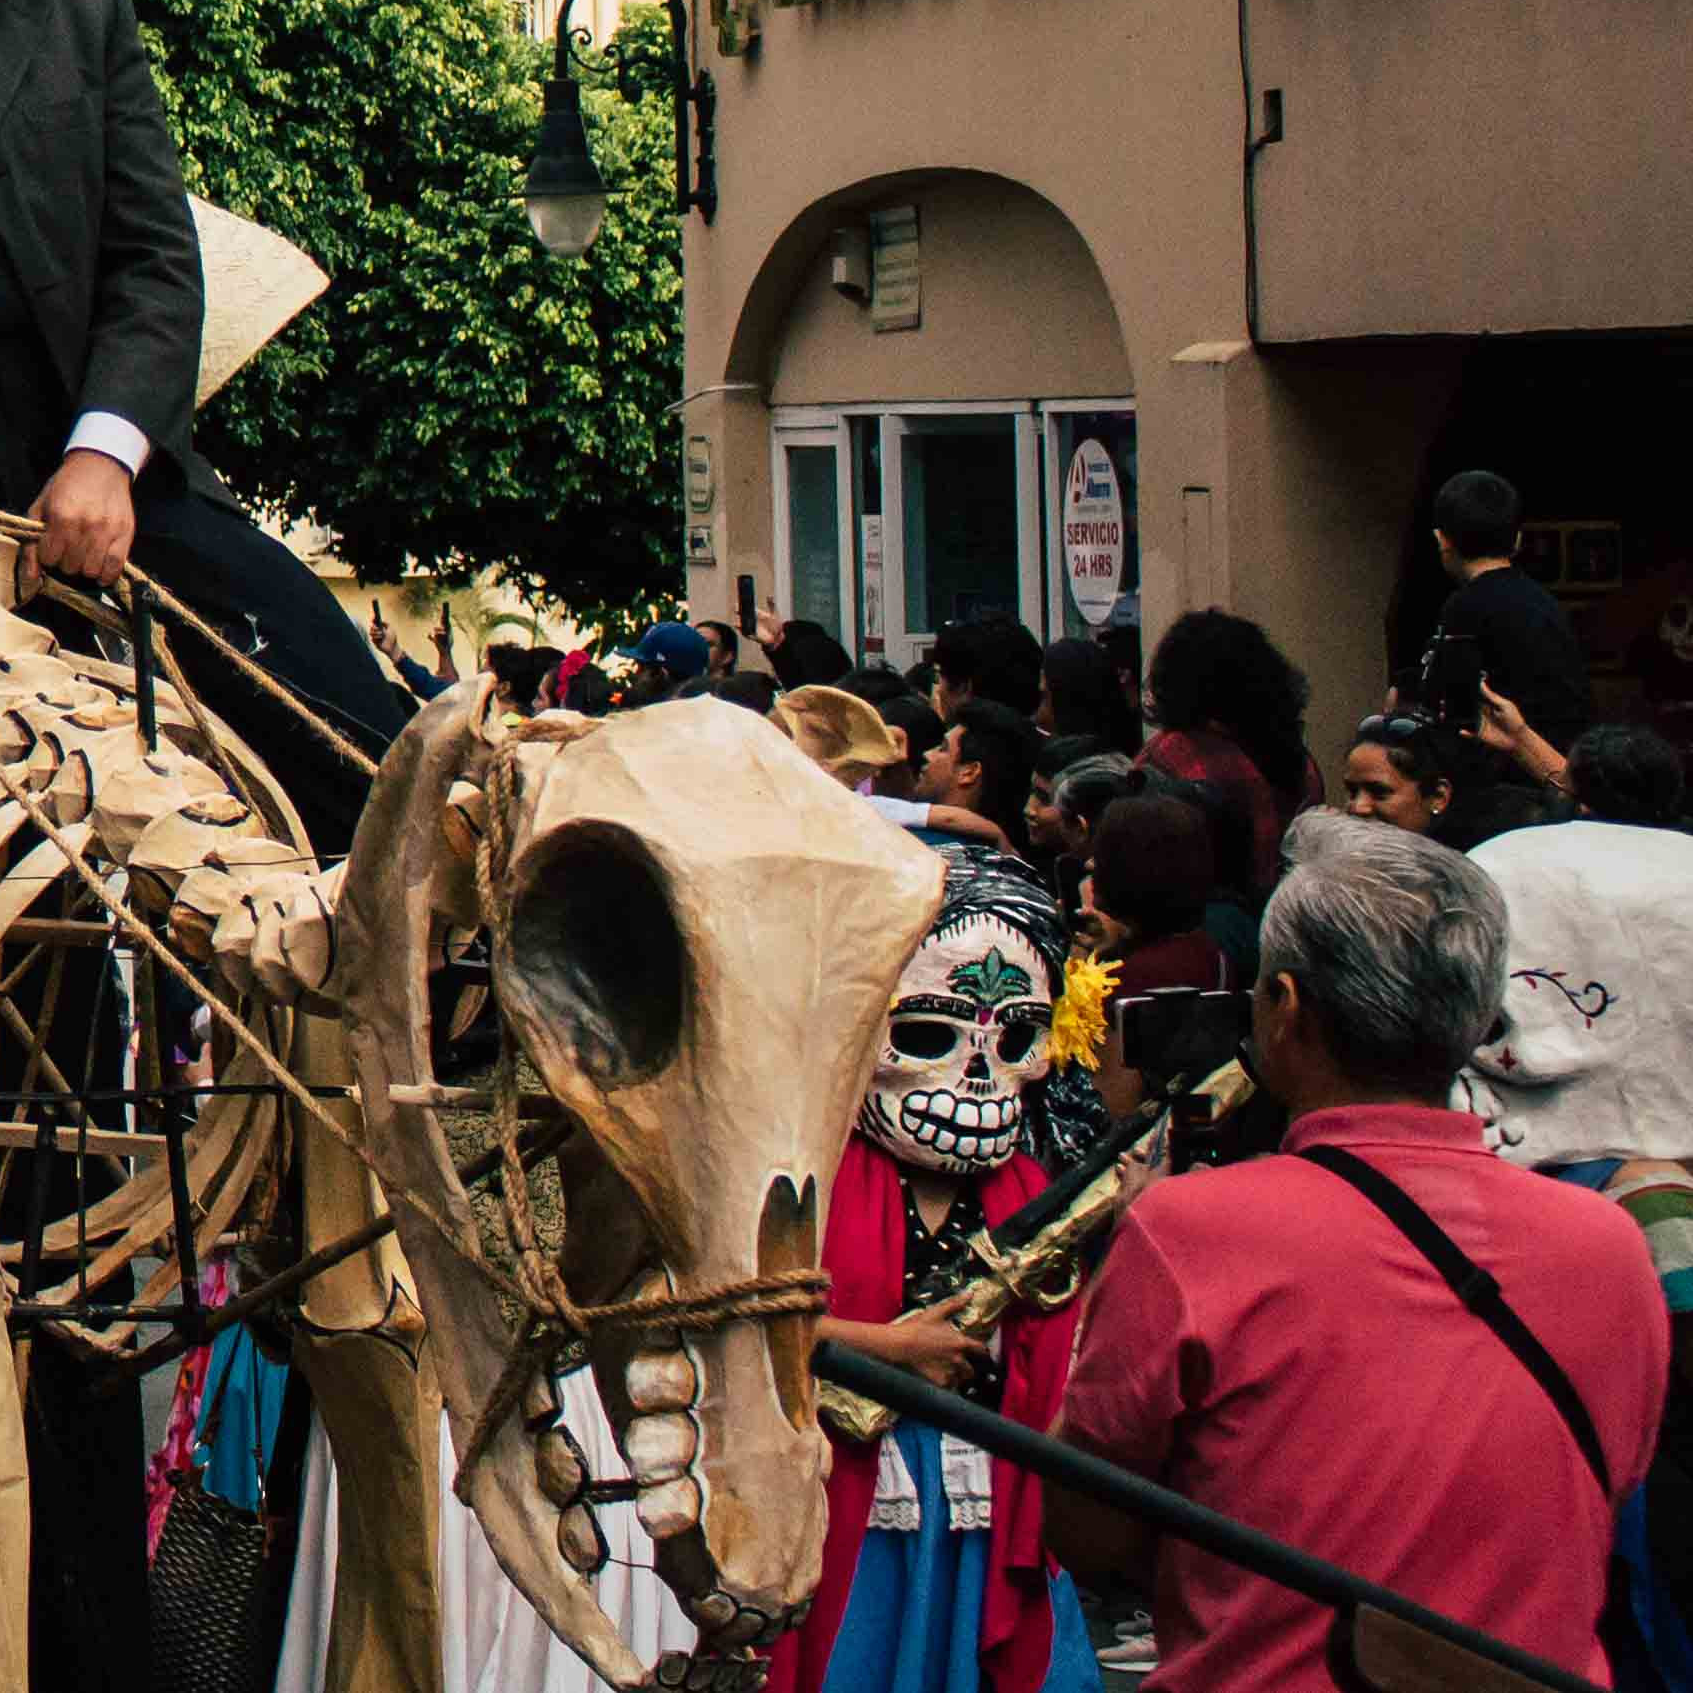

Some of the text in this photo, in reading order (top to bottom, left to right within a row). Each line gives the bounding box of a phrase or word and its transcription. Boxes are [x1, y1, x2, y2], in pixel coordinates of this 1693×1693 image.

[1067, 521, 1119, 547] SERVICIO
[1073, 553, 1113, 578] 24 HRS
